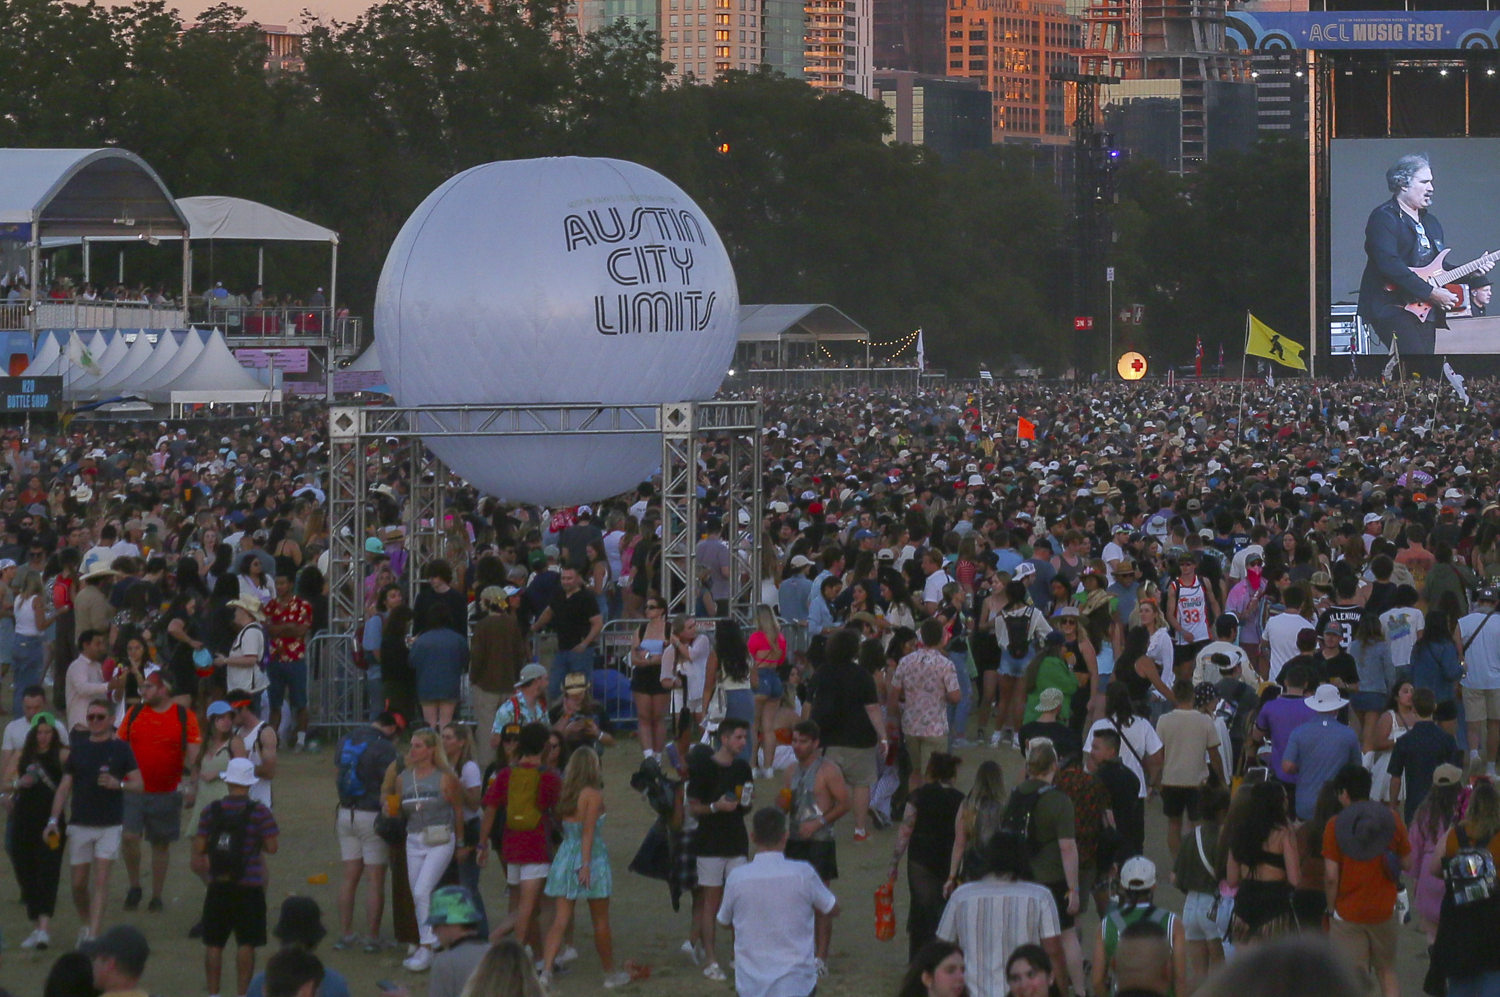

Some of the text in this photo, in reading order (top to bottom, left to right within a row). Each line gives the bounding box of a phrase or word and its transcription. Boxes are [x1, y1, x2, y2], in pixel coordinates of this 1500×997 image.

[1309, 23, 1444, 42] ACL MUSIC FEST
[563, 206, 707, 252] AUSTIN
[606, 245, 694, 286] CITY
[594, 291, 716, 335] LIMITS
[7, 394, 31, 409] BOTTLE
[1183, 608, 1200, 623] 33
[1329, 612, 1361, 622] ILLENIUM
